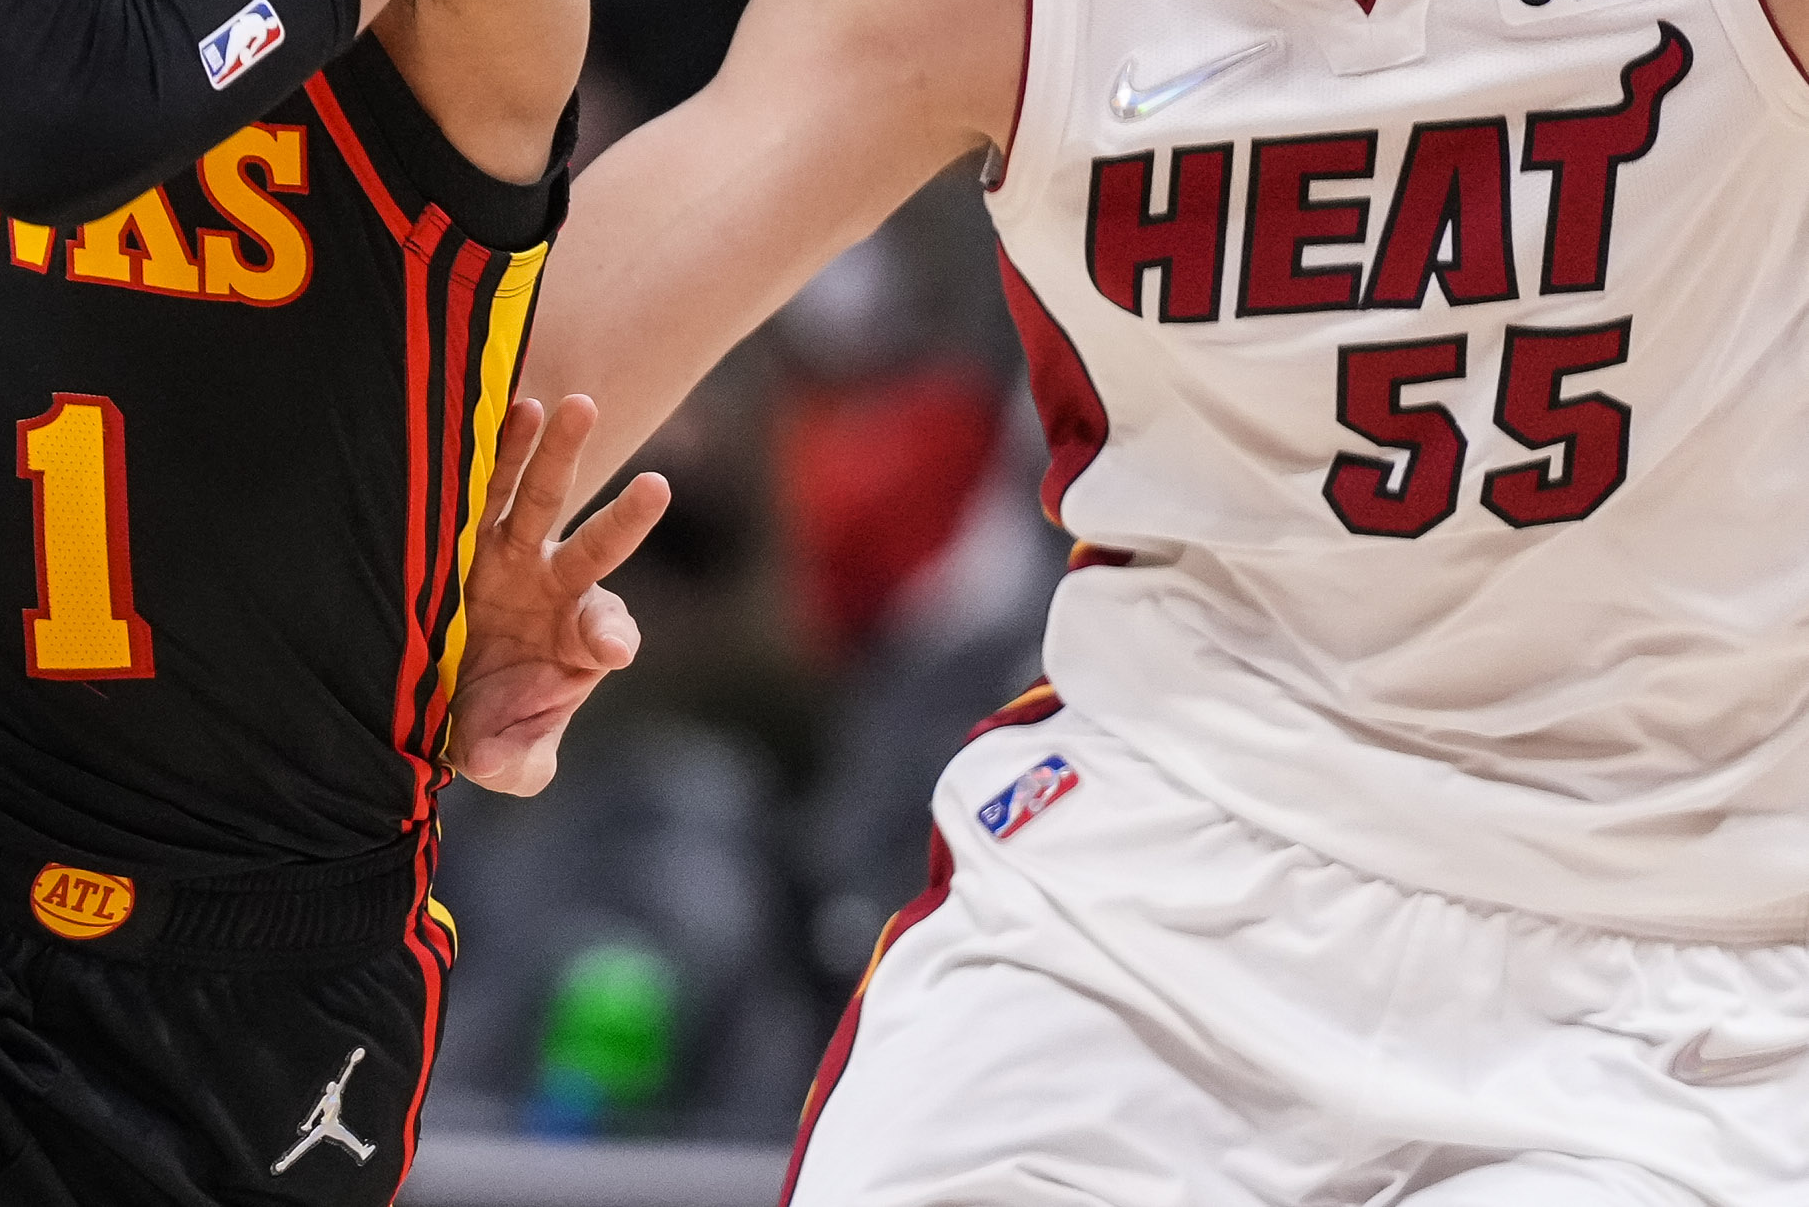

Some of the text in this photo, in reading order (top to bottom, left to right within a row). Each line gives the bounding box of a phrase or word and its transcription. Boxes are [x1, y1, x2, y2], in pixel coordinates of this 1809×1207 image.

[1085, 19, 1694, 324] HEAT
[1321, 315, 1633, 539] 55
[42, 872, 115, 920] ATL
